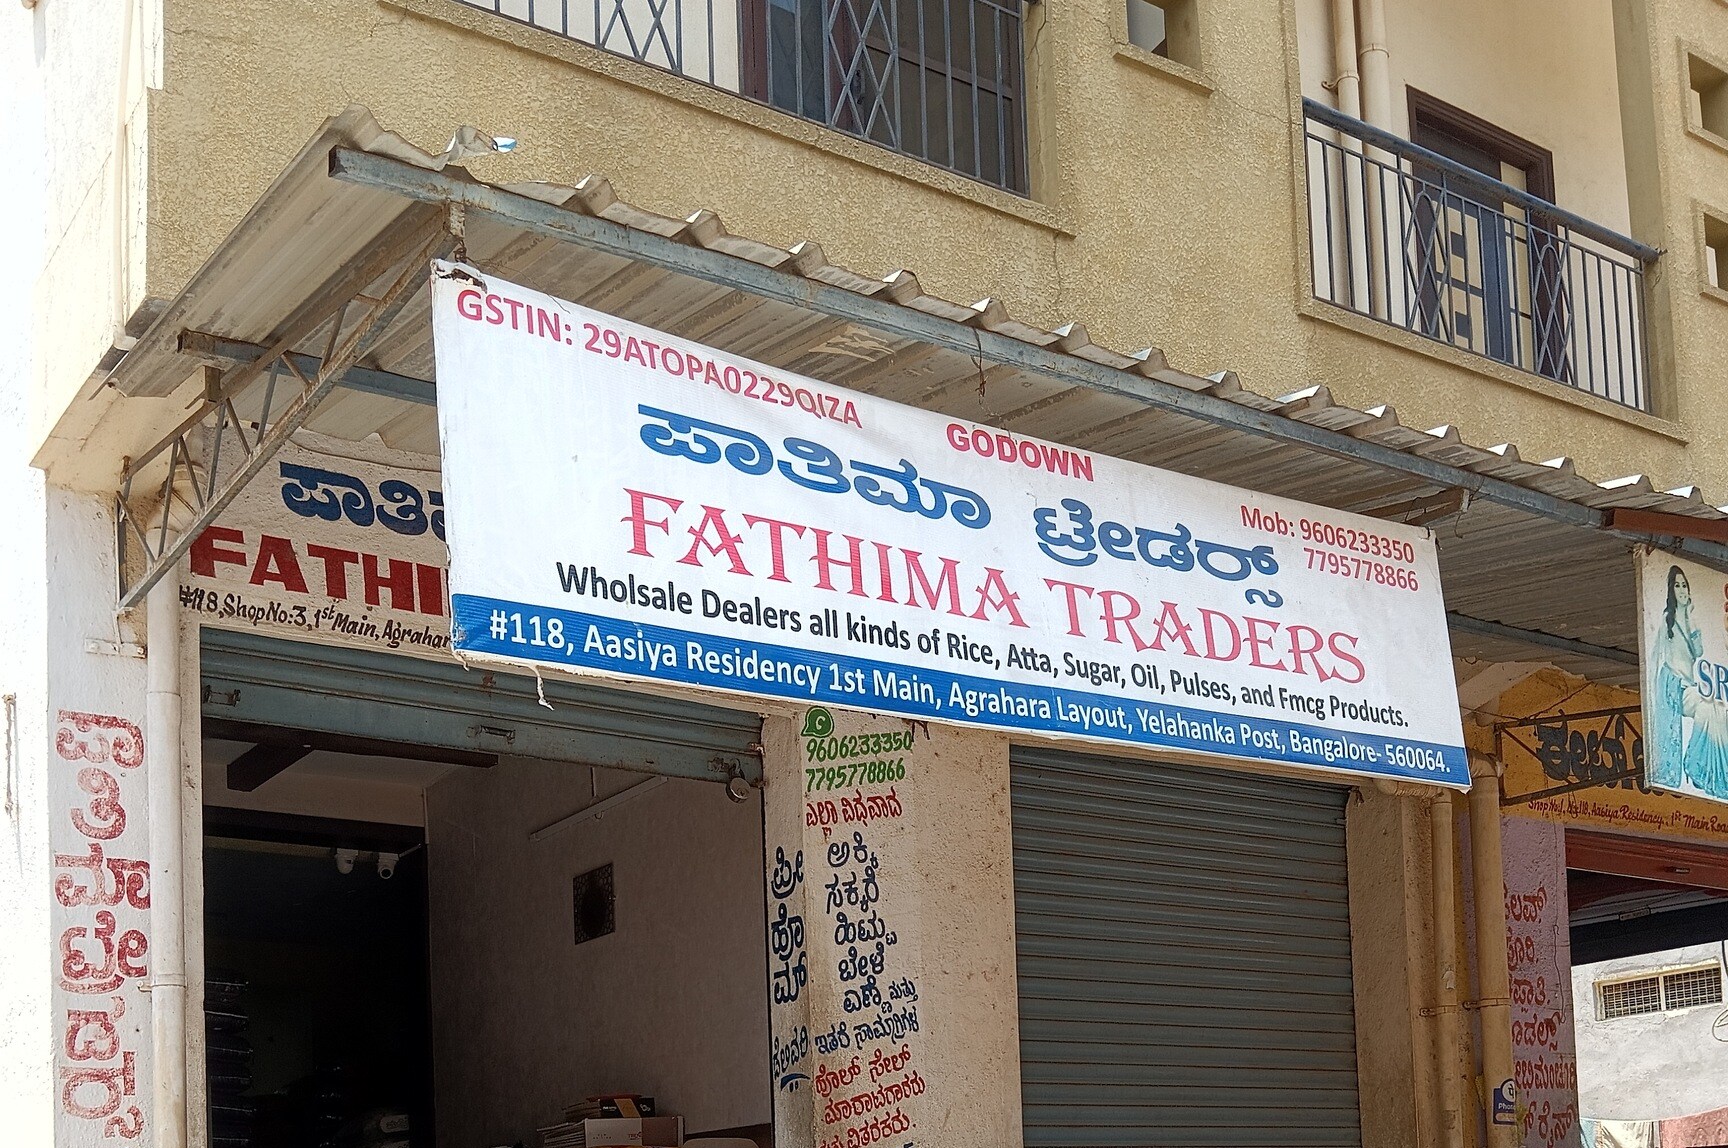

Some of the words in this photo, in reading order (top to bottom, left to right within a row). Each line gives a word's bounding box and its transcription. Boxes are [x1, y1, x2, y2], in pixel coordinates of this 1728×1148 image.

[458, 290, 572, 345] GSTIN:
[946, 423, 1094, 482] GODOWN
[1241, 505, 1295, 538] Mob:
[1299, 519, 1415, 565] 9606233350
[190, 526, 450, 616] FATHI
[620, 488, 1031, 629] FATHIMA
[1043, 578, 1365, 684] TRADERS
[1304, 548, 1418, 592] 7795778866
[332, 613, 379, 641] Main,
[382, 619, 450, 648] Agrahar
[556, 562, 692, 615] Wholsale
[701, 589, 802, 633] Dealers
[810, 608, 838, 638] all
[846, 612, 910, 651] kinds
[917, 628, 941, 656] of
[947, 633, 1000, 670] Rice,
[1007, 644, 1058, 679] Atta,
[1065, 652, 1126, 690] Sugar,
[1131, 663, 1165, 695] Oil,
[1171, 670, 1236, 706] Pulses,
[1241, 684, 1274, 709] and
[1279, 688, 1325, 721] Fmcg
[1330, 695, 1409, 728] Products.
[490, 609, 574, 656] #118,
[584, 625, 677, 671] Aasiya
[687, 642, 821, 695] Residency
[829, 663, 866, 694] 1st
[872, 670, 942, 710] Main,
[949, 682, 1051, 720] Agrahara
[1056, 696, 1133, 734] Layout,
[1136, 708, 1236, 745] Yelahanka
[1239, 723, 1286, 755] Post,
[1289, 729, 1382, 763] Bangalore-
[1385, 744, 1451, 773] 560064.
[806, 731, 912, 762] 9606233350
[806, 758, 906, 792] 7795778866
[1710, 816, 1728, 832] Roa
